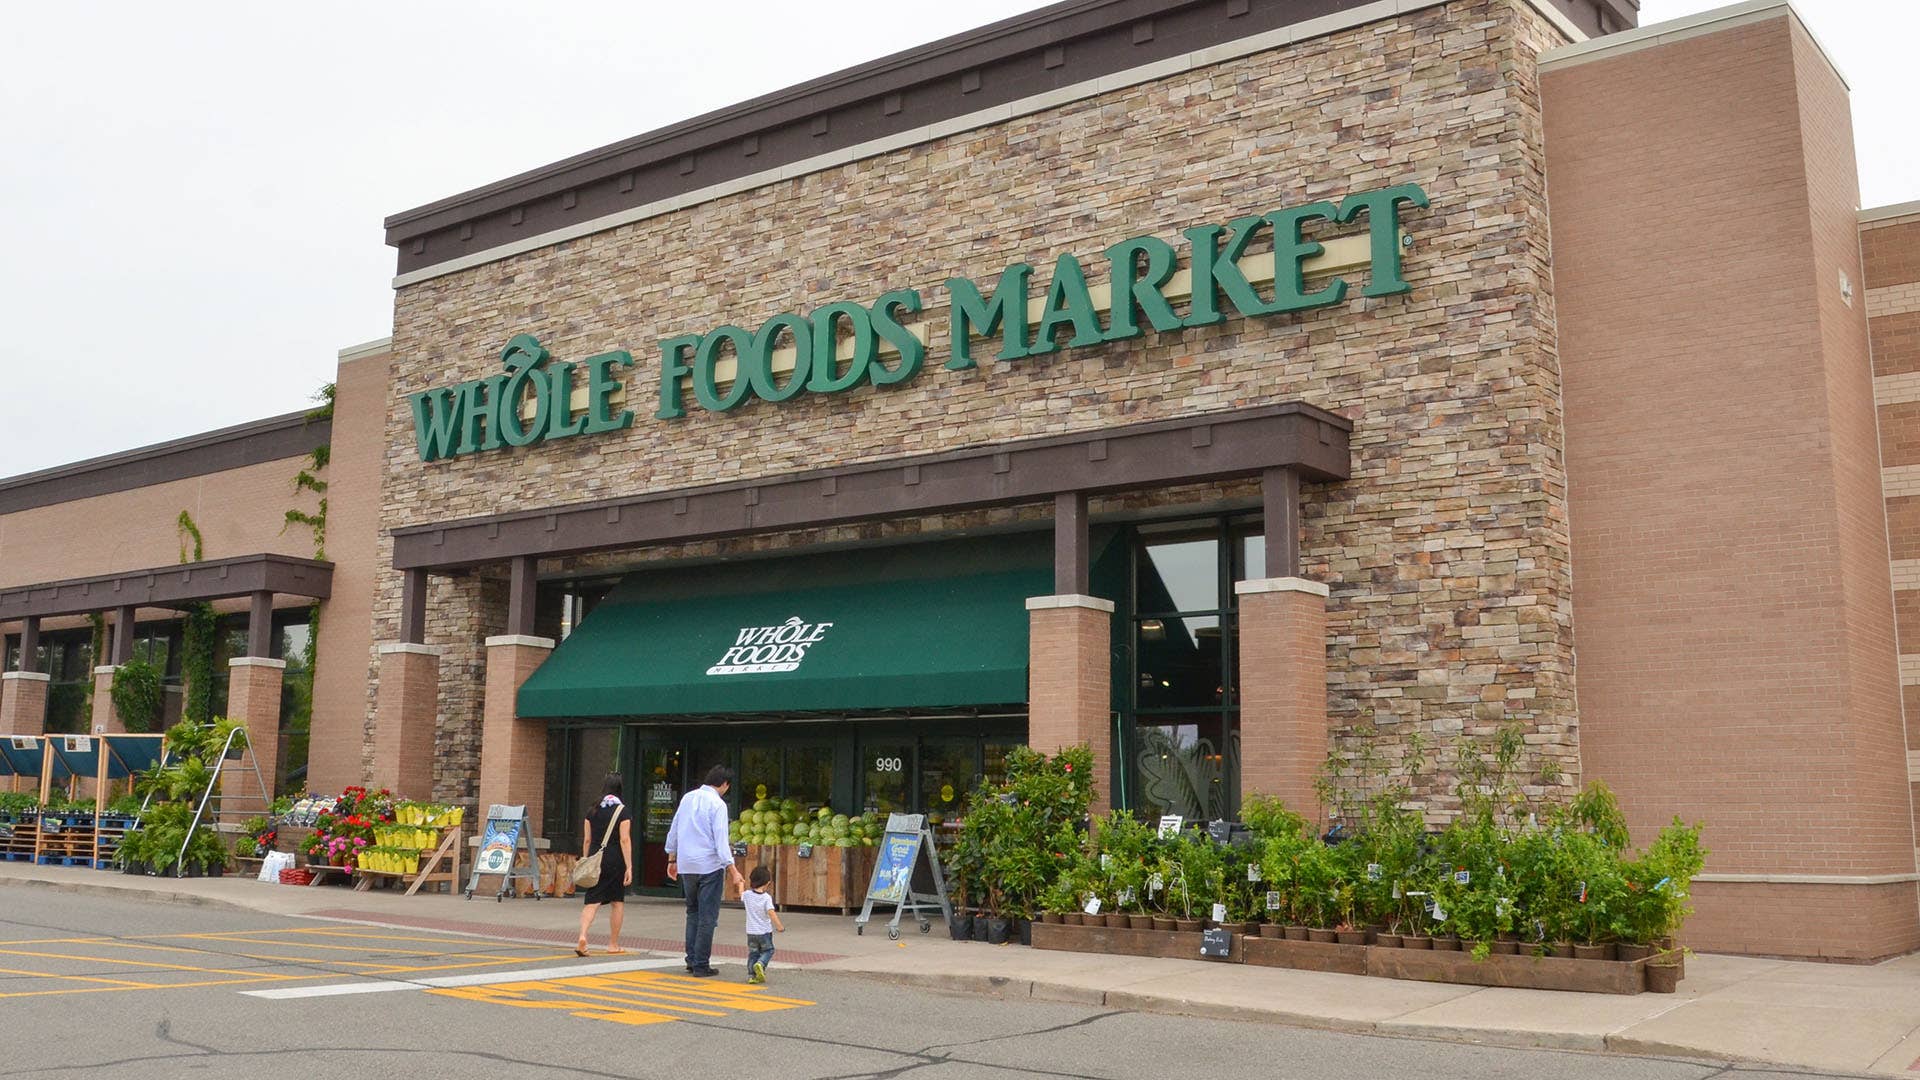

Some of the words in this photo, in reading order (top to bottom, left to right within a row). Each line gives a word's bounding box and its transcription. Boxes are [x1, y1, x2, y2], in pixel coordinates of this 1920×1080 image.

[412, 333, 634, 463] WHOLE
[654, 289, 926, 420] FOODS
[944, 182, 1430, 371] MARKET
[735, 616, 833, 646] WHOLE
[716, 642, 812, 666] FOODS
[712, 664, 794, 673] MARKET
[876, 757, 902, 772] 990
[653, 781, 673, 791] WHOLE
